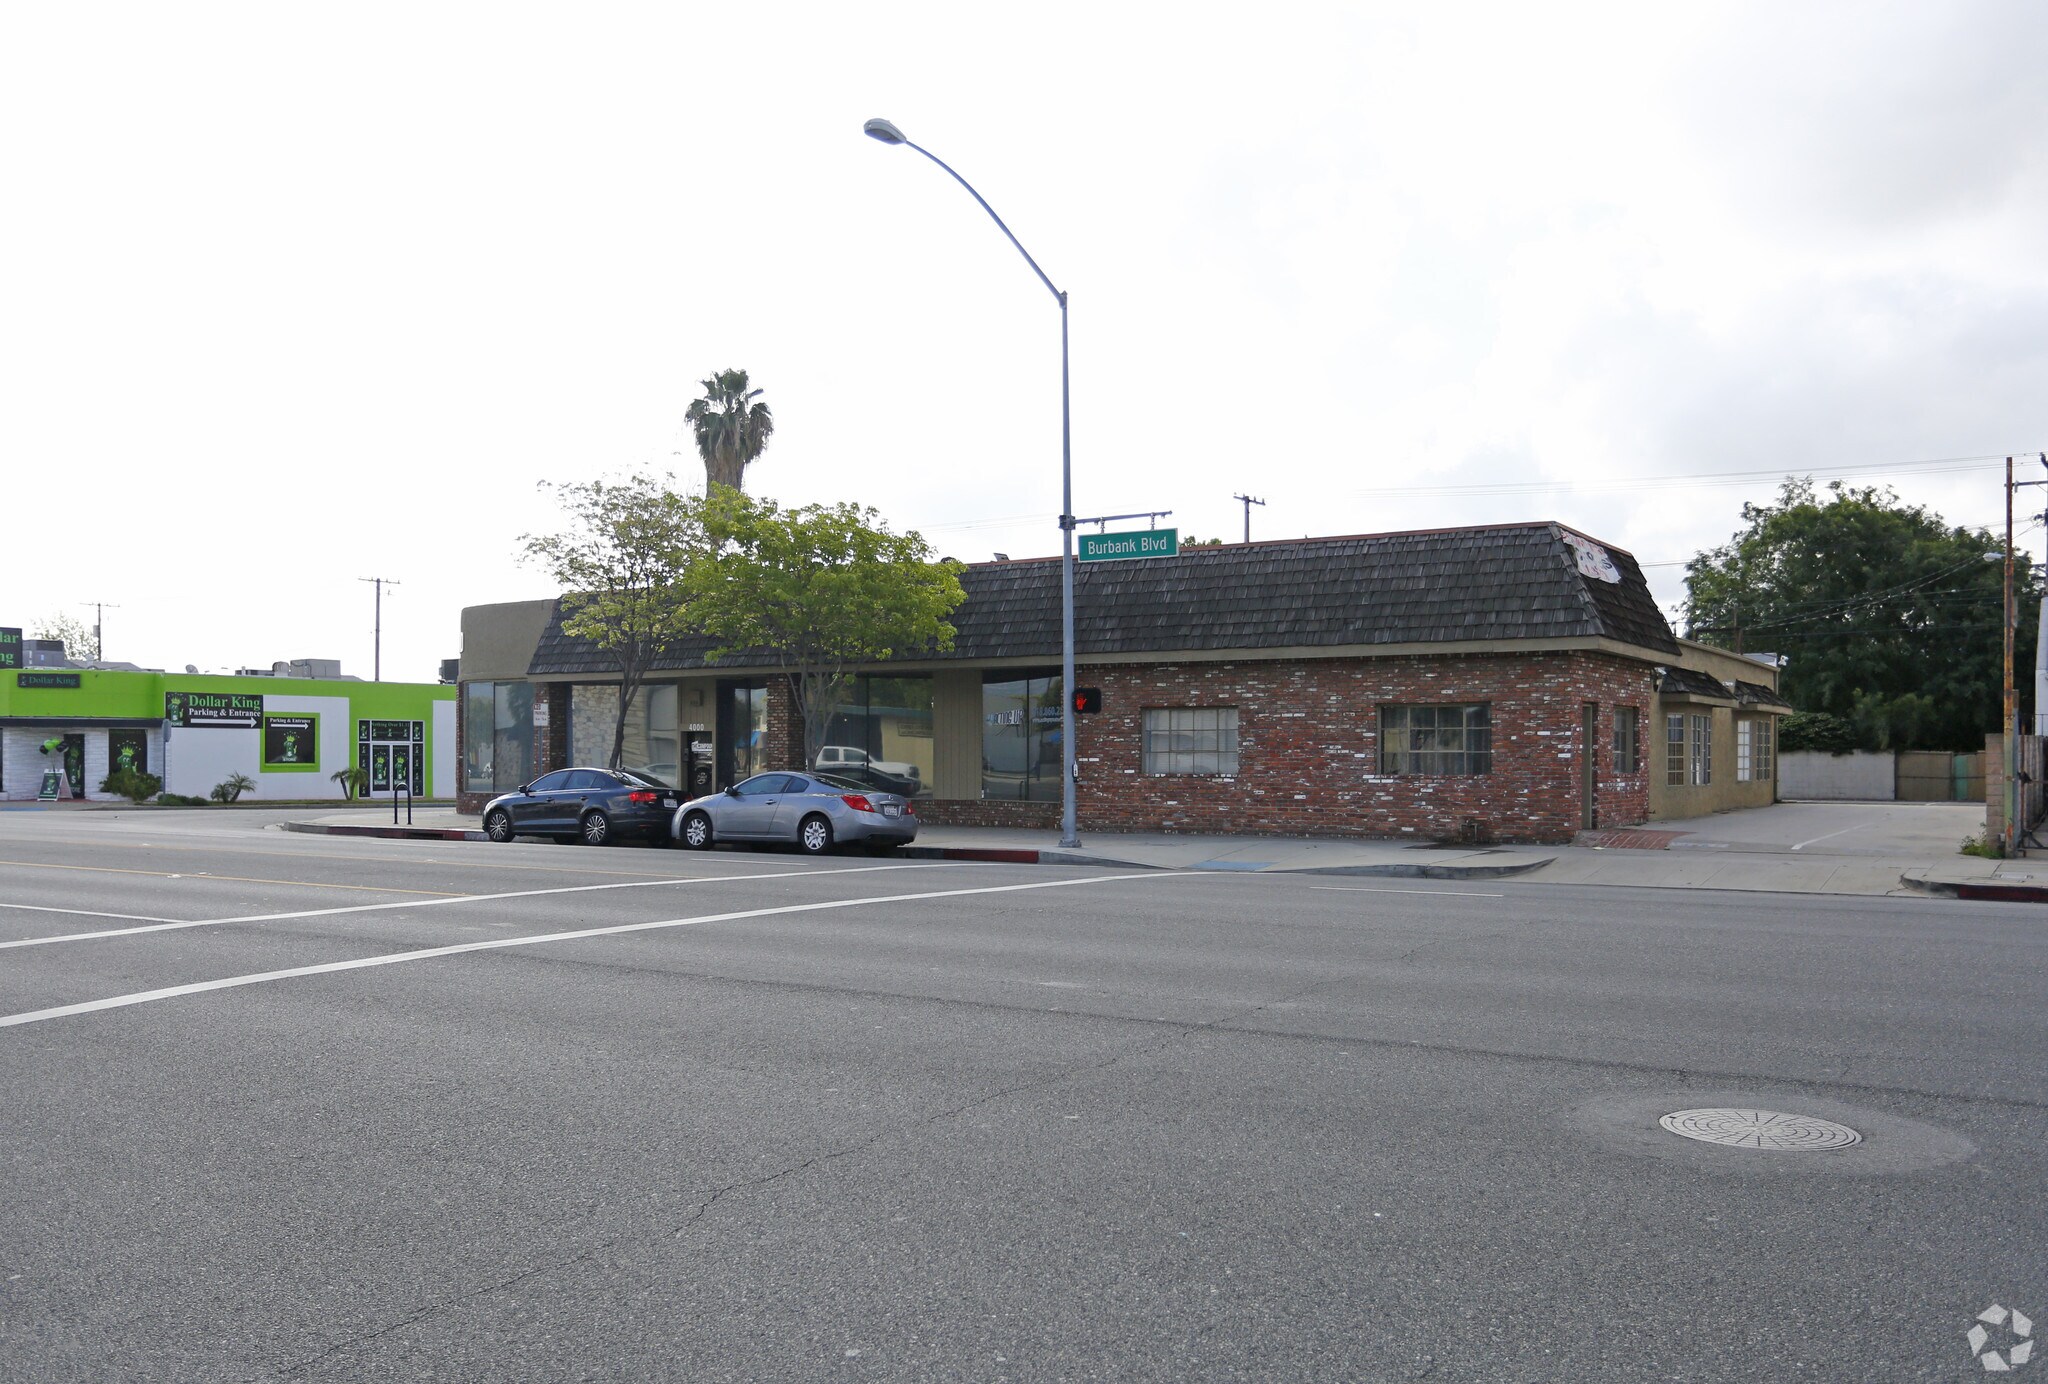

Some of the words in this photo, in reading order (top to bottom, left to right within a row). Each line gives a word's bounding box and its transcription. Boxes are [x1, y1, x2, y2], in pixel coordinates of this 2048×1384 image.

[1087, 538, 1136, 555] Burbank
[1141, 536, 1167, 551] Blvd
[29, 676, 54, 684] Dollar
[56, 677, 77, 686] King
[188, 694, 228, 707] Dollar
[231, 695, 261, 711] King
[188, 708, 218, 718] Parking
[219, 708, 227, 717] &
[229, 709, 261, 718] Entrance
[688, 723, 704, 731] 4000
